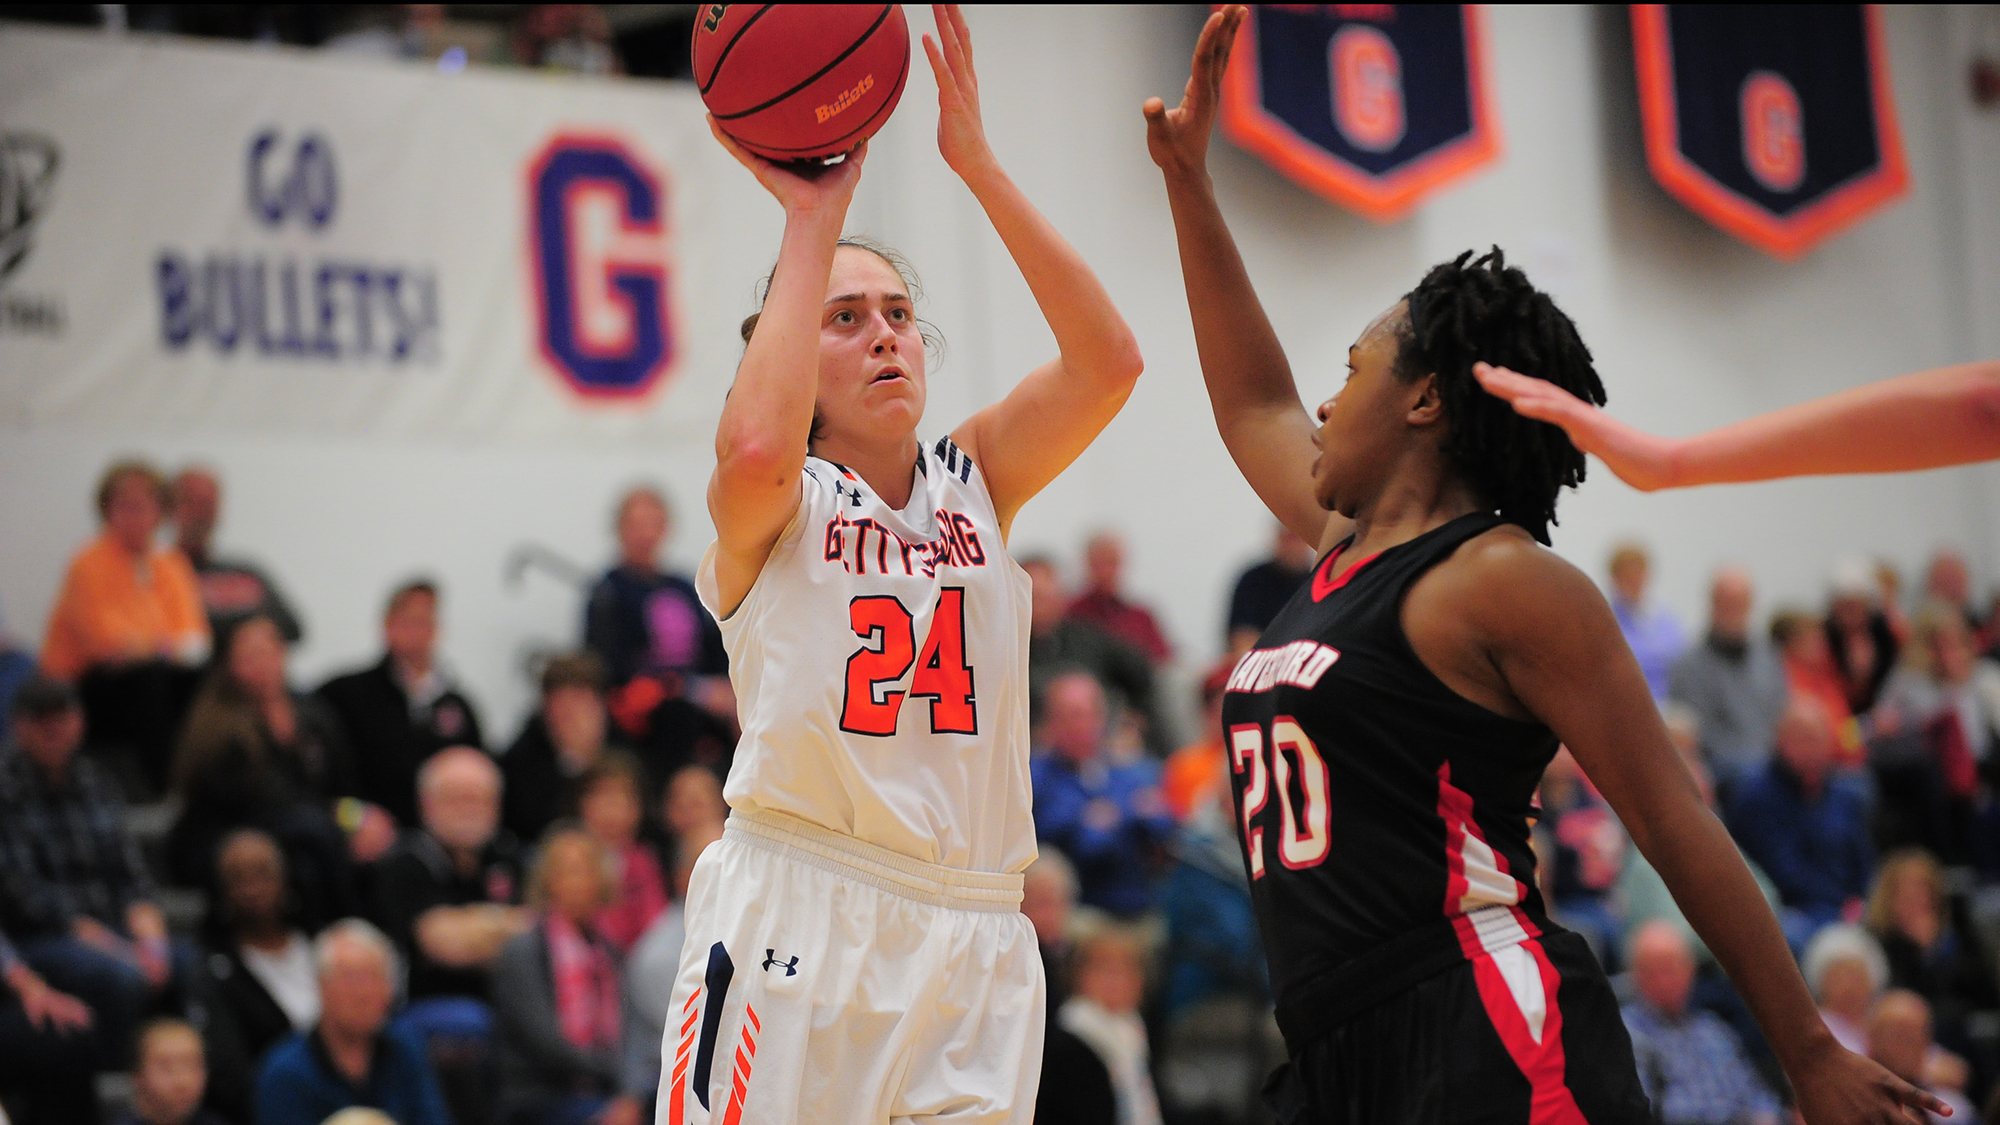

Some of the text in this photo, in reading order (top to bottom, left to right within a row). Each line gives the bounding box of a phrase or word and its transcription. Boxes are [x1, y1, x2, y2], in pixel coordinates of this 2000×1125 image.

[815, 74, 874, 124] Bullets
[245, 128, 341, 229] GO
[528, 130, 675, 406] G
[838, 586, 979, 736] 24
[1230, 714, 1332, 881] 20
